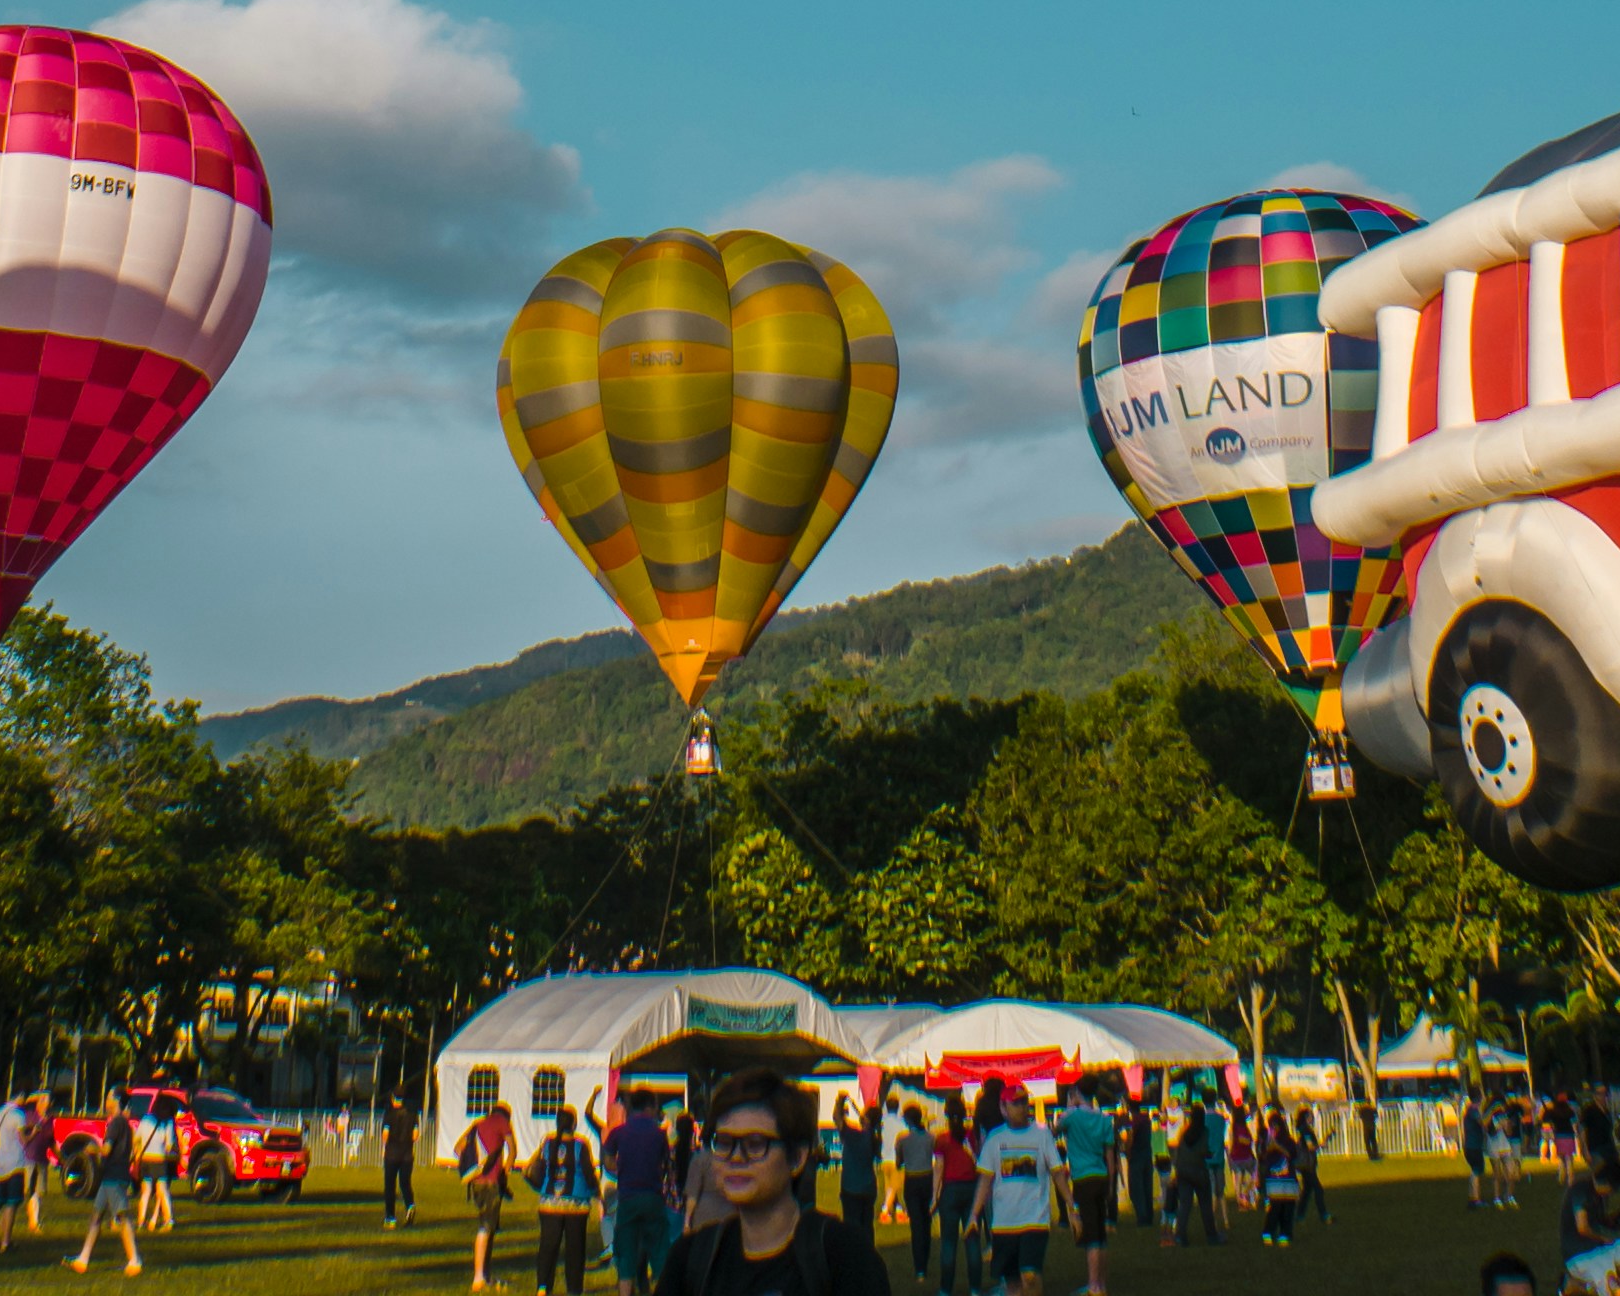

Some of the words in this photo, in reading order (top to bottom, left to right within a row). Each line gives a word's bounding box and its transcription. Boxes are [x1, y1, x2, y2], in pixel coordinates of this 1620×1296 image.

[1106, 390, 1169, 439] IJM
[1176, 370, 1313, 419] LAND
[1208, 436, 1242, 455] IJM
[1249, 436, 1313, 448] Company
